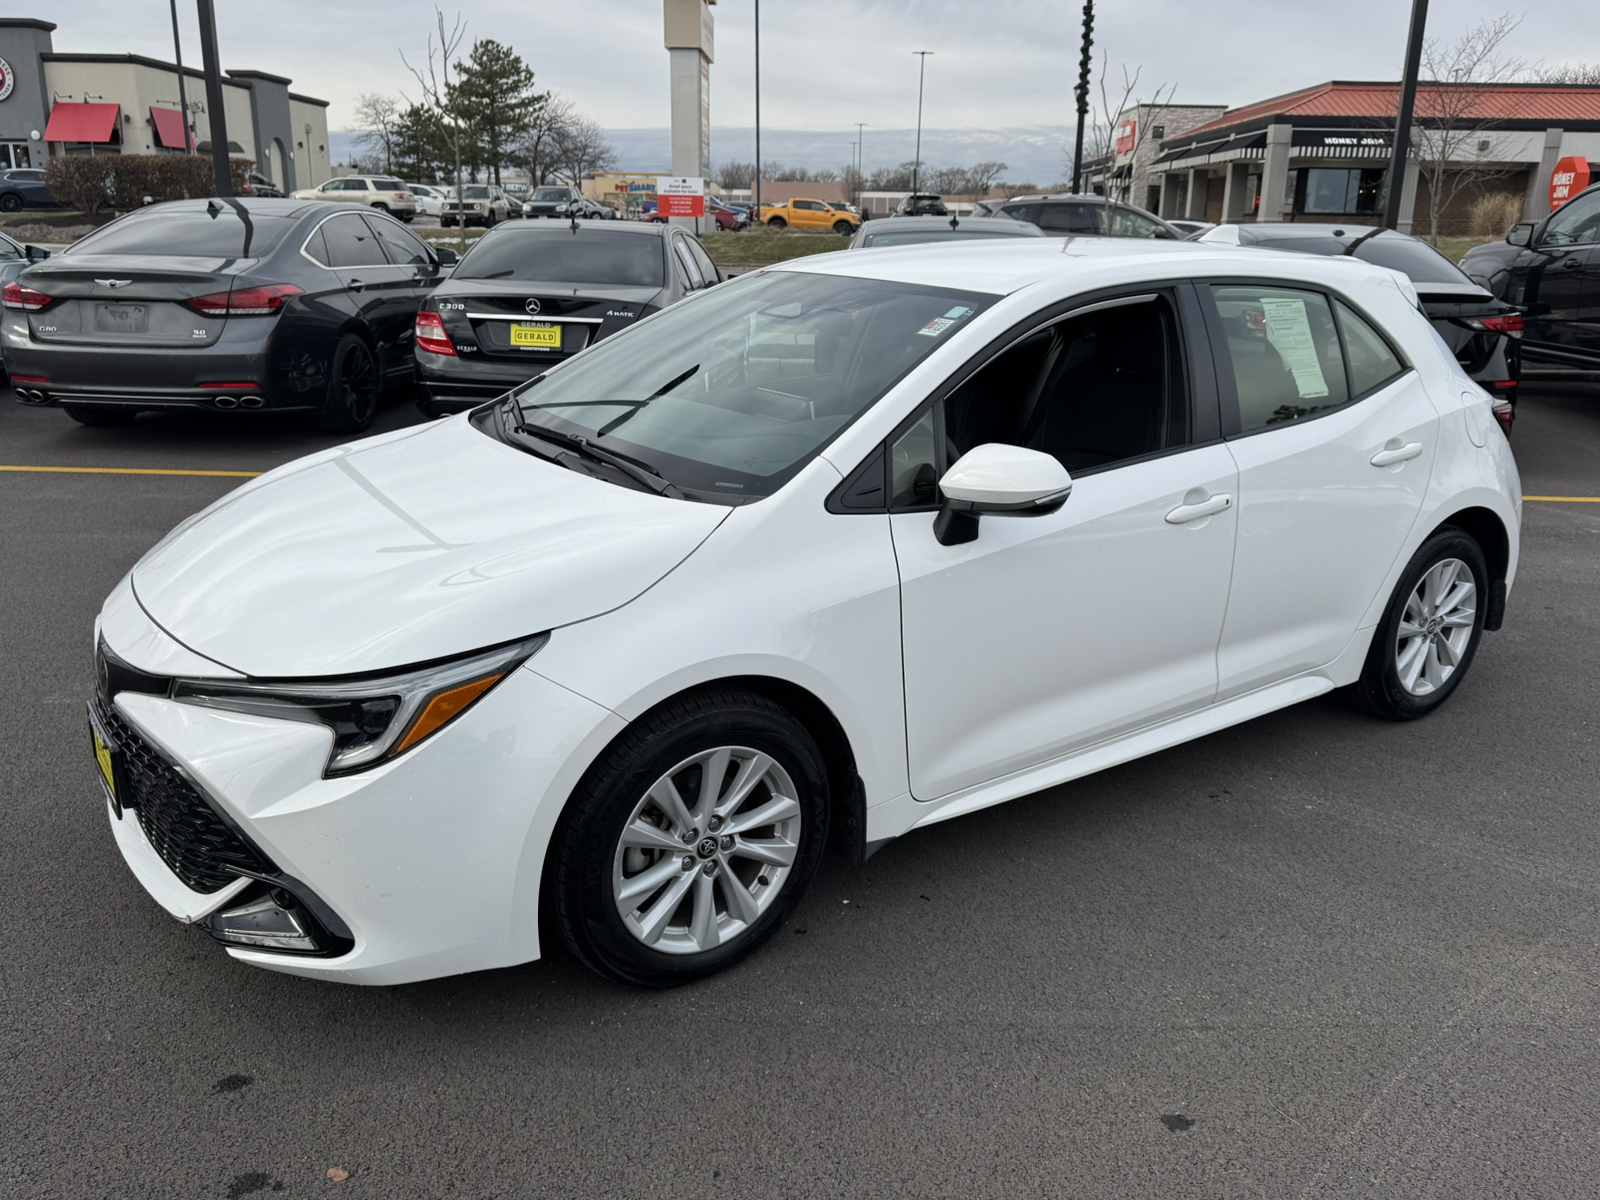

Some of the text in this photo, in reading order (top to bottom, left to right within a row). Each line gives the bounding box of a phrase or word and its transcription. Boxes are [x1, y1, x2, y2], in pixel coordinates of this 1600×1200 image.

[1324, 137, 1358, 145] HONEY
[1552, 171, 1576, 186] HONEY
[1553, 186, 1570, 198] JAM
[517, 333, 554, 341] GERALD
